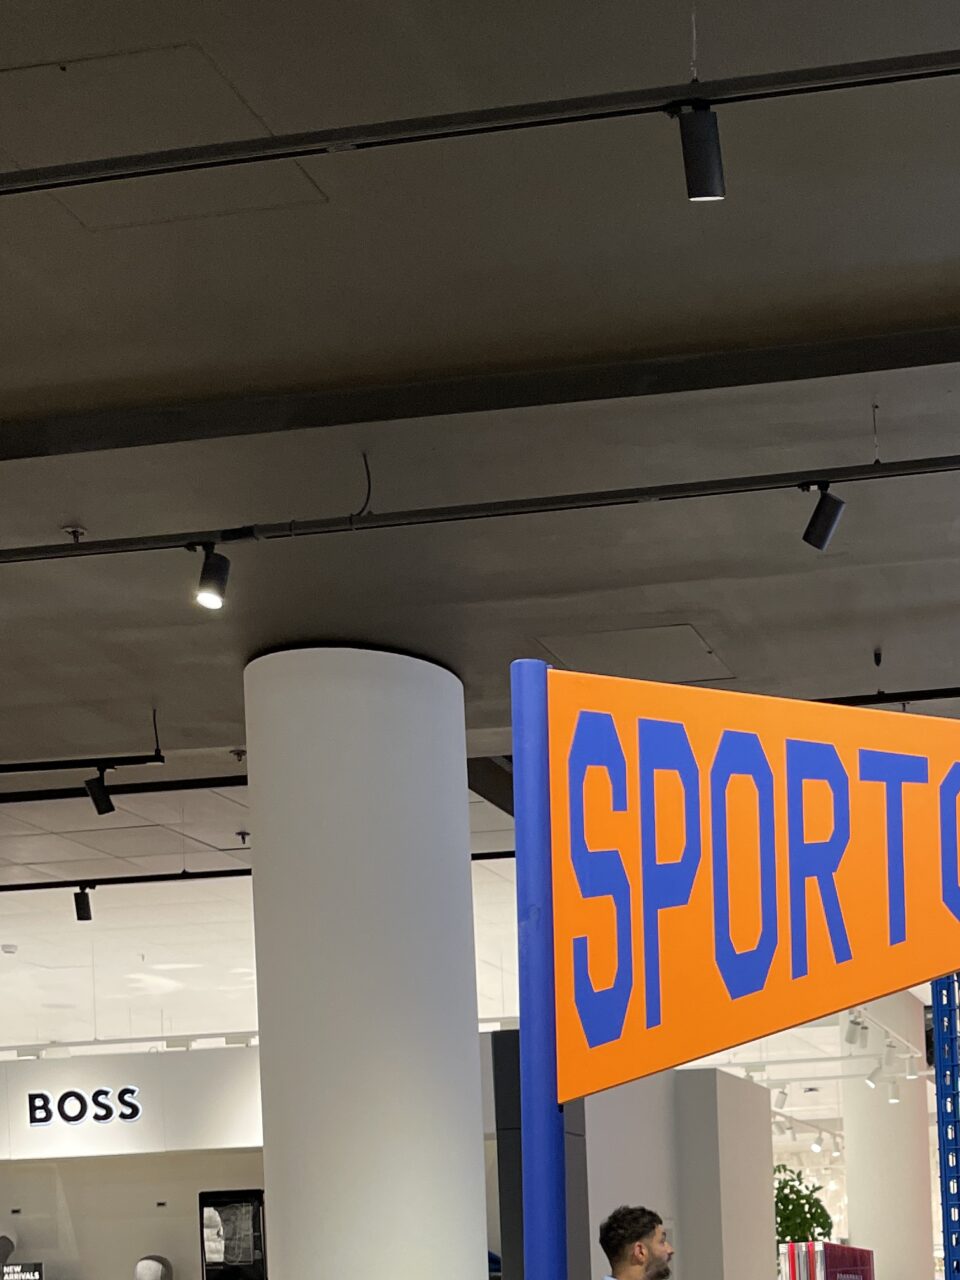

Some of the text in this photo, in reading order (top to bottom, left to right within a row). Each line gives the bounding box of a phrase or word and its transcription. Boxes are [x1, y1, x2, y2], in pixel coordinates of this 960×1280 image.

[28, 1087, 141, 1126] BOSS
[3, 1265, 22, 1273] NEW
[3, 1271, 40, 1280] ARRIVALS
